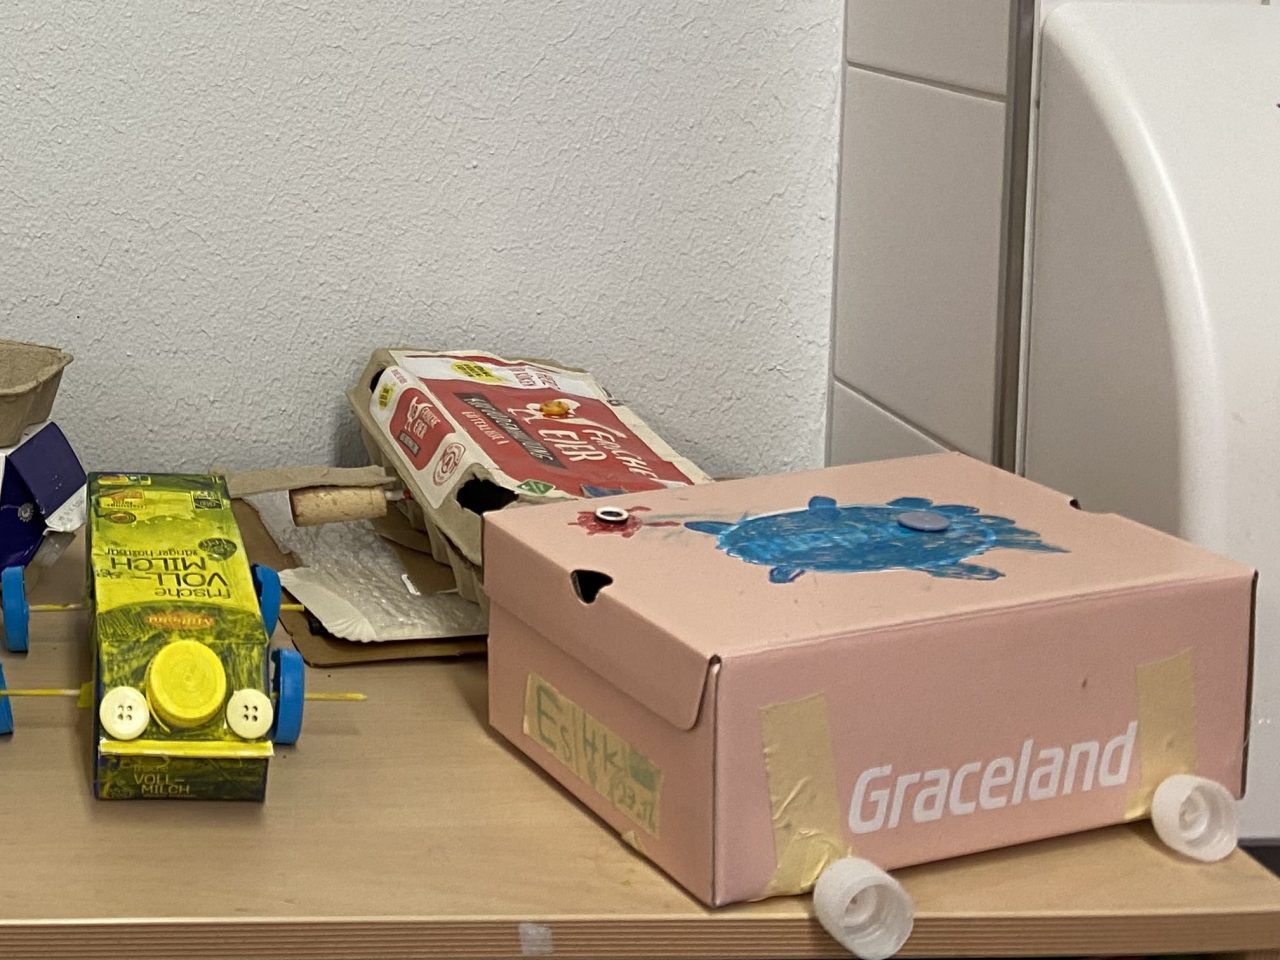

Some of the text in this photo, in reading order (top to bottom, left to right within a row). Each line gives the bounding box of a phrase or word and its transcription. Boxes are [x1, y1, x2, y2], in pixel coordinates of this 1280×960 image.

[537, 429, 608, 462] EIER
[110, 556, 207, 572] MILCH
[848, 720, 1138, 834] Graceland
[141, 784, 190, 795] MILCH
